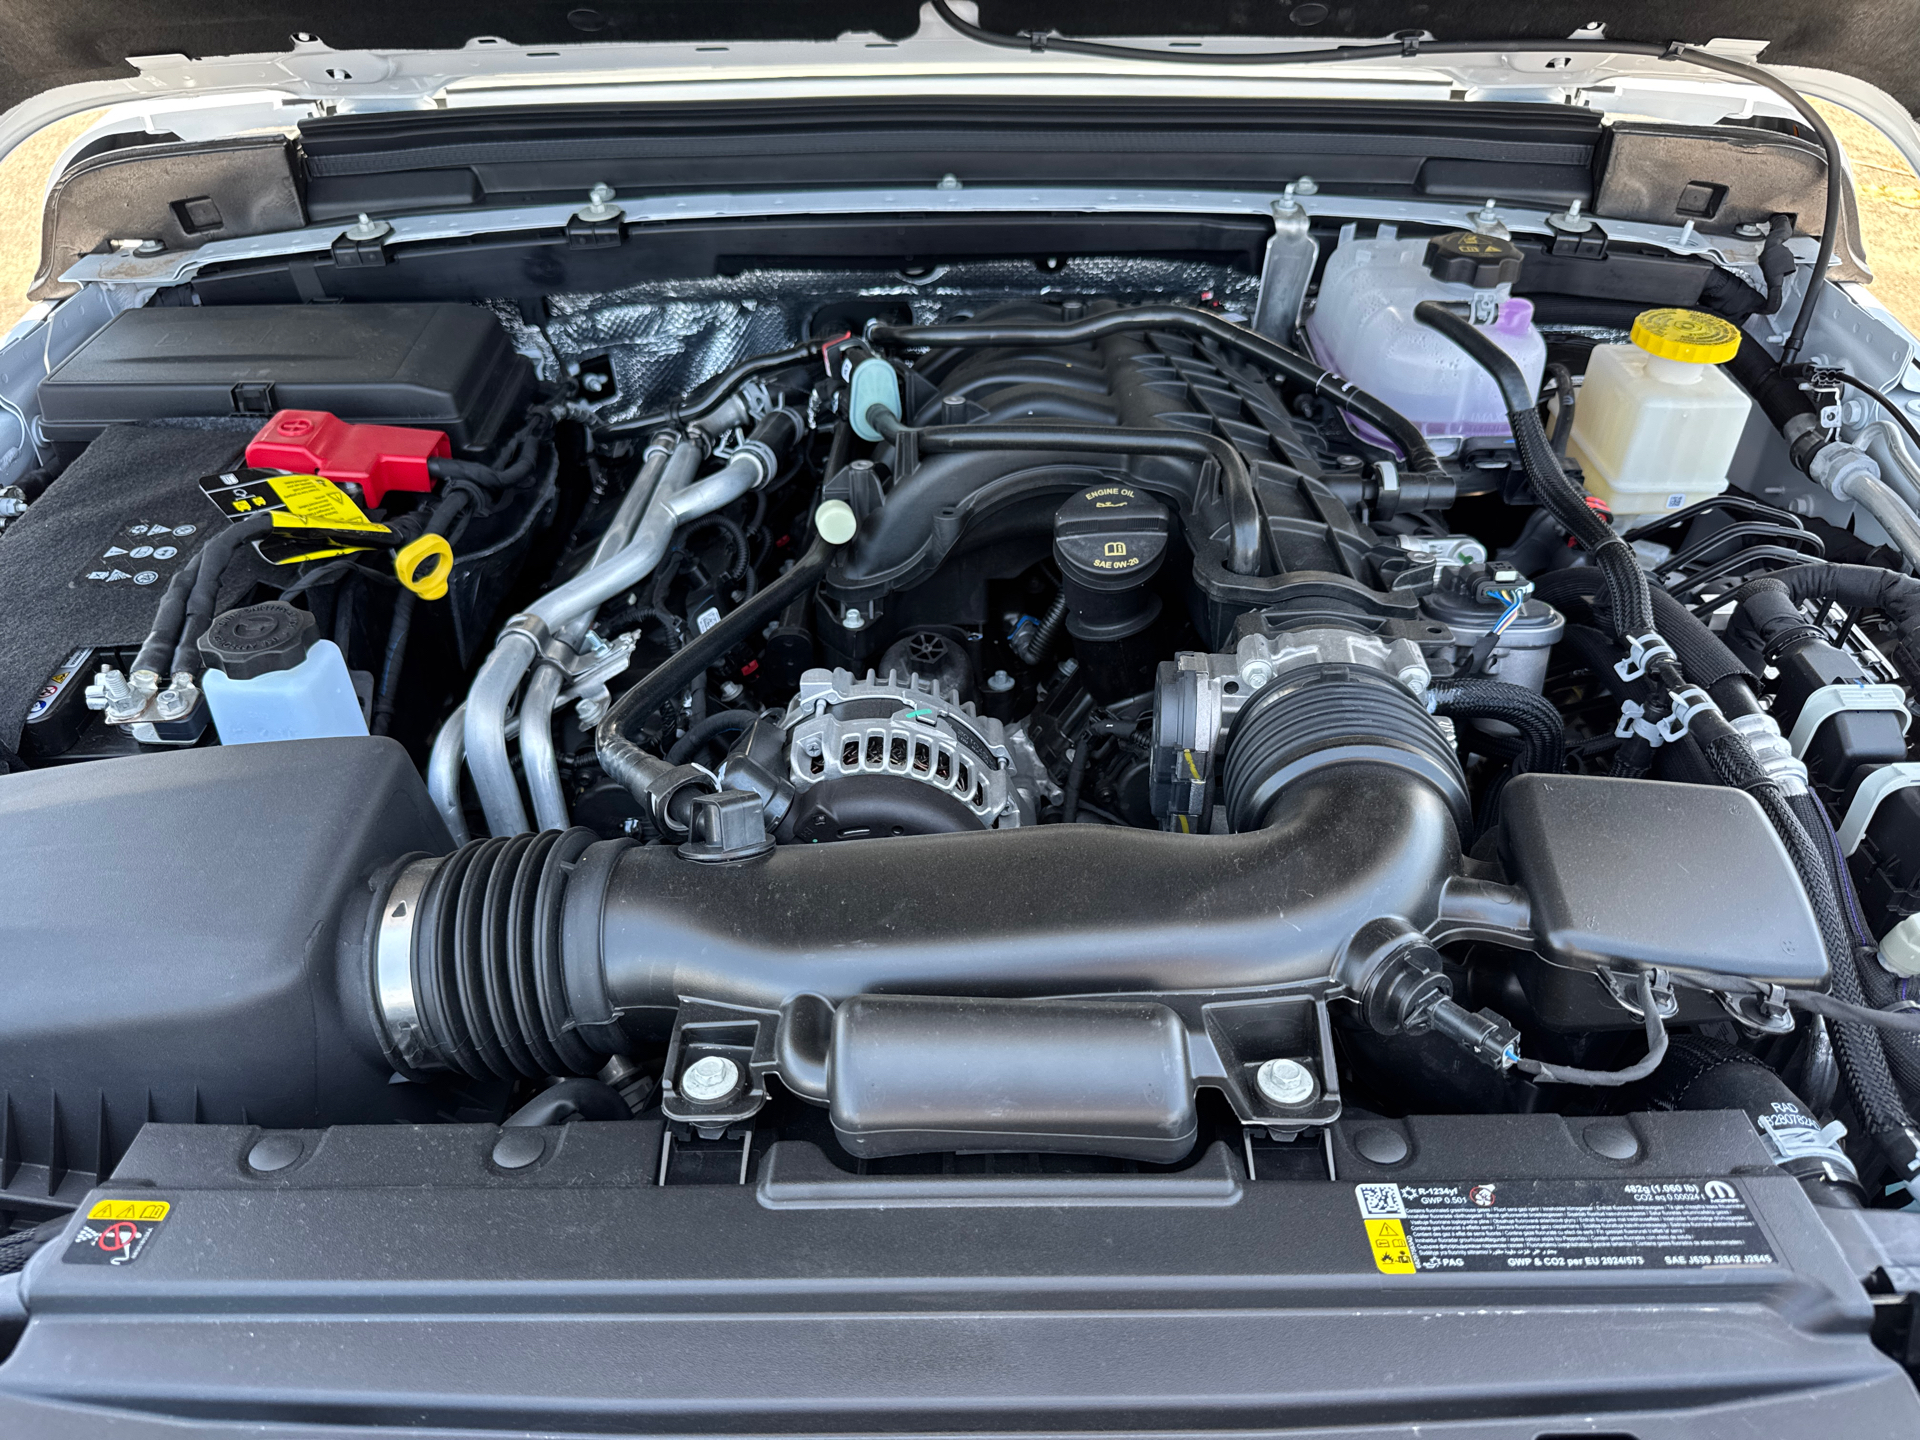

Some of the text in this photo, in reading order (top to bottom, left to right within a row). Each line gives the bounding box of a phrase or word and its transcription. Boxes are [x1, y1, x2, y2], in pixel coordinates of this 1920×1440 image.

[1085, 488, 1135, 500] ENGINE OIL
[1093, 557, 1140, 569] SAE 0W-20
[1770, 1102, 1799, 1114] RAD
[1418, 1187, 1458, 1196] R-1234yf
[1624, 1184, 1651, 1194] 482g
[1684, 1183, 1700, 1194] lb)
[1420, 1195, 1468, 1204] GWP 0.501
[1633, 1194, 1654, 1202] CO2
[1655, 1194, 1667, 1202] eq
[1442, 1258, 1465, 1267] PAG
[1507, 1256, 1645, 1268] GWP & CO2 per EU 2024/573
[1664, 1253, 1773, 1265] SAE J639 J2842 J2845
